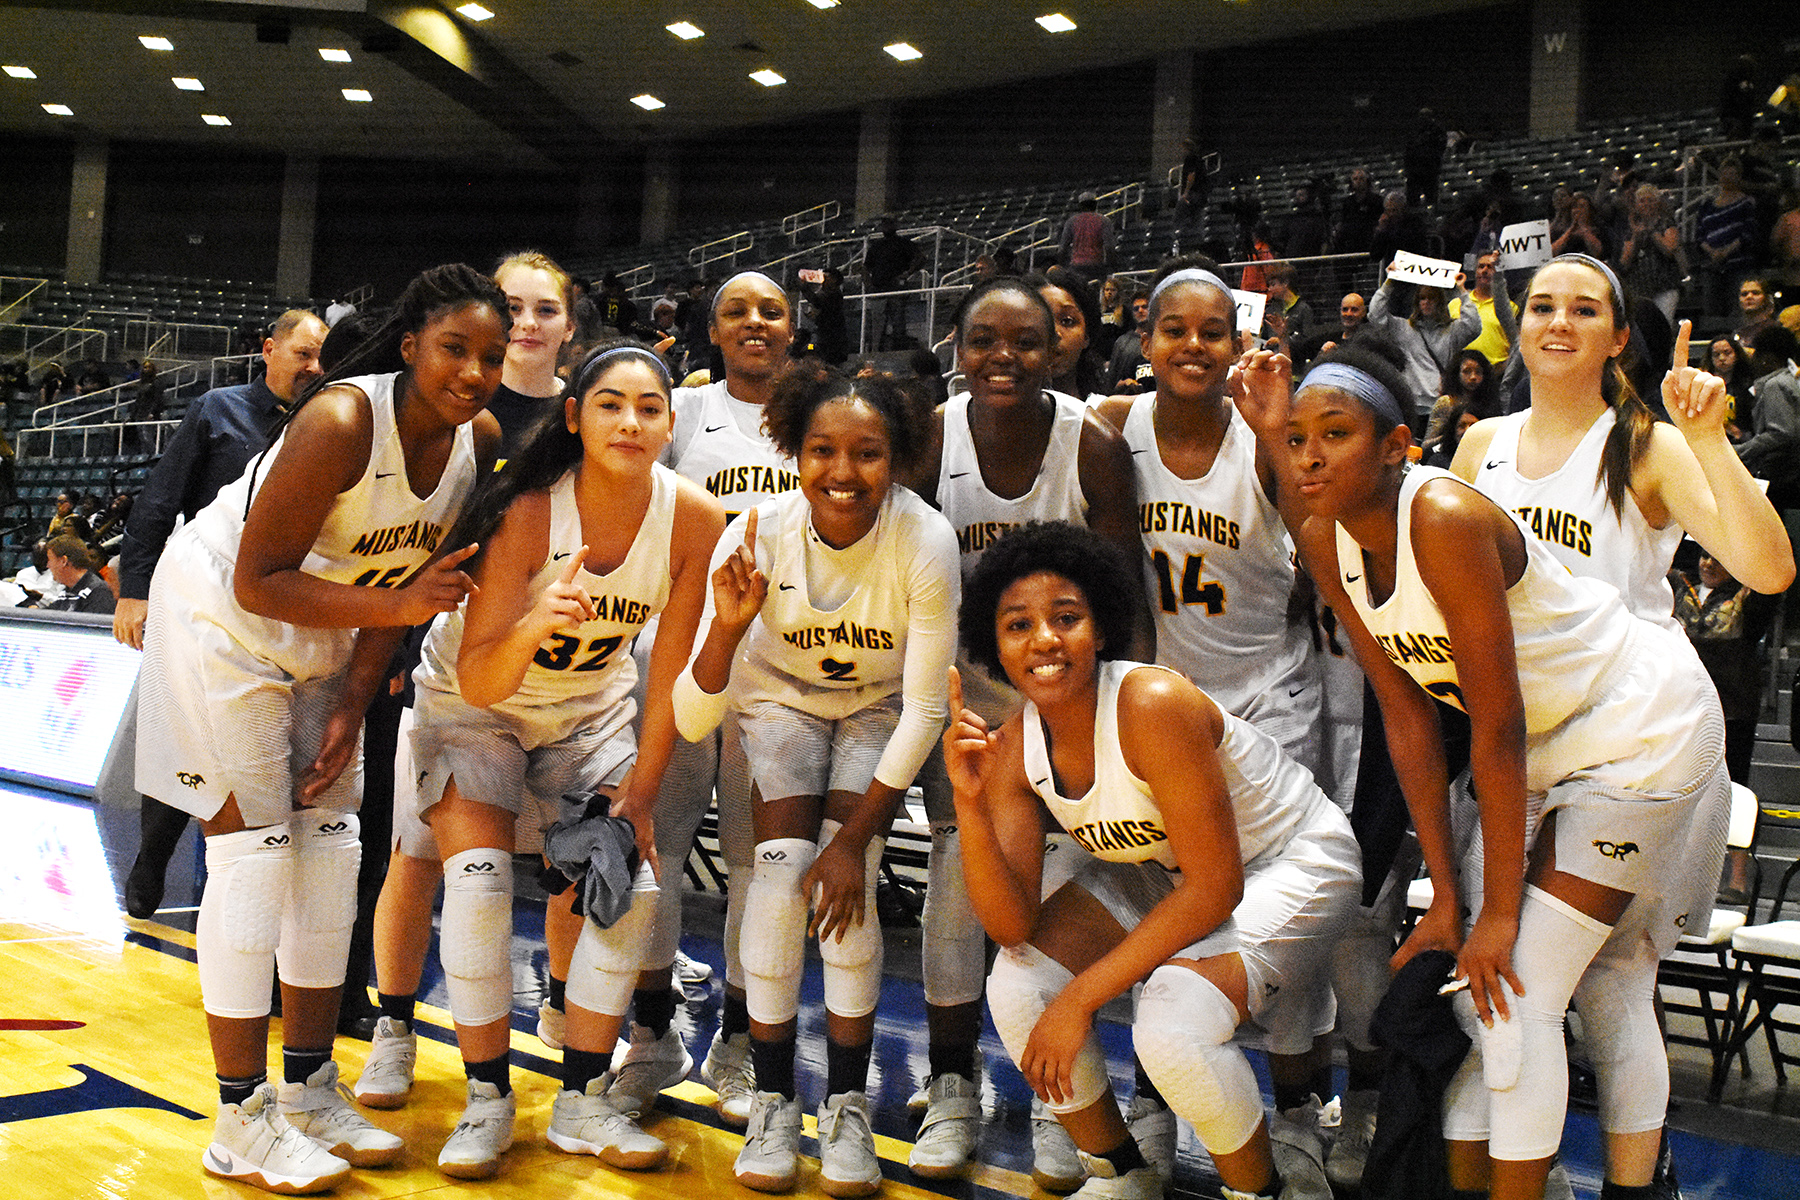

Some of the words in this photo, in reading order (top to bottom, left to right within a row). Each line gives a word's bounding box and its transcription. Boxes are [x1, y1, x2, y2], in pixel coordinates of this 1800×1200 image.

[1544, 31, 1567, 53] W
[1139, 501, 1240, 550] USTANGS
[1152, 548, 1227, 617] 14
[782, 619, 894, 650] MUSTANGS
[532, 632, 625, 672] 32
[818, 656, 860, 682] 2
[1071, 819, 1168, 853] STANGS
